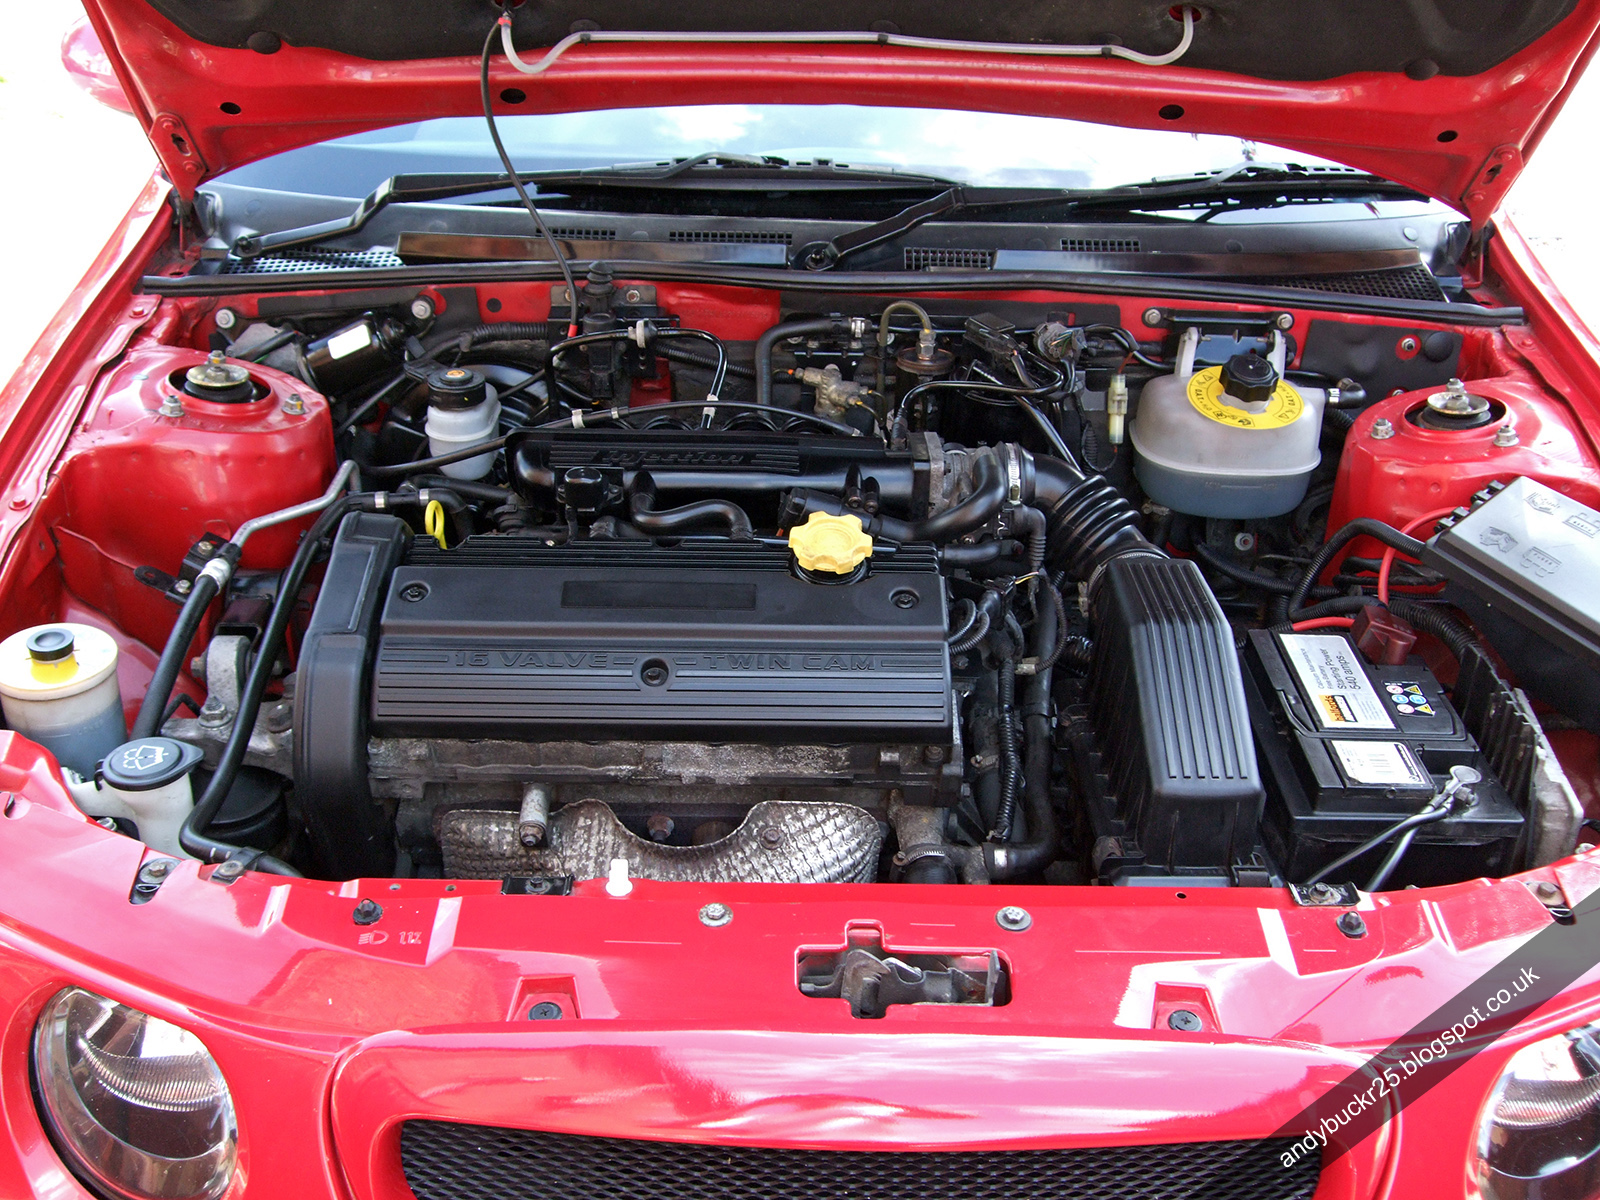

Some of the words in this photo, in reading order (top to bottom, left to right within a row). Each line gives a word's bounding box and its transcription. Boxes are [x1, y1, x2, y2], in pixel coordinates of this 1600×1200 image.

[454, 651, 490, 668] 16
[499, 652, 608, 669] VALVE
[702, 654, 790, 670] TWIN
[803, 654, 876, 672] CAM
[1319, 648, 1334, 667] Power
[1336, 655, 1354, 675] amps
[1329, 665, 1347, 690] Starting
[1345, 676, 1361, 690] 540
[1324, 695, 1345, 721] halfords
